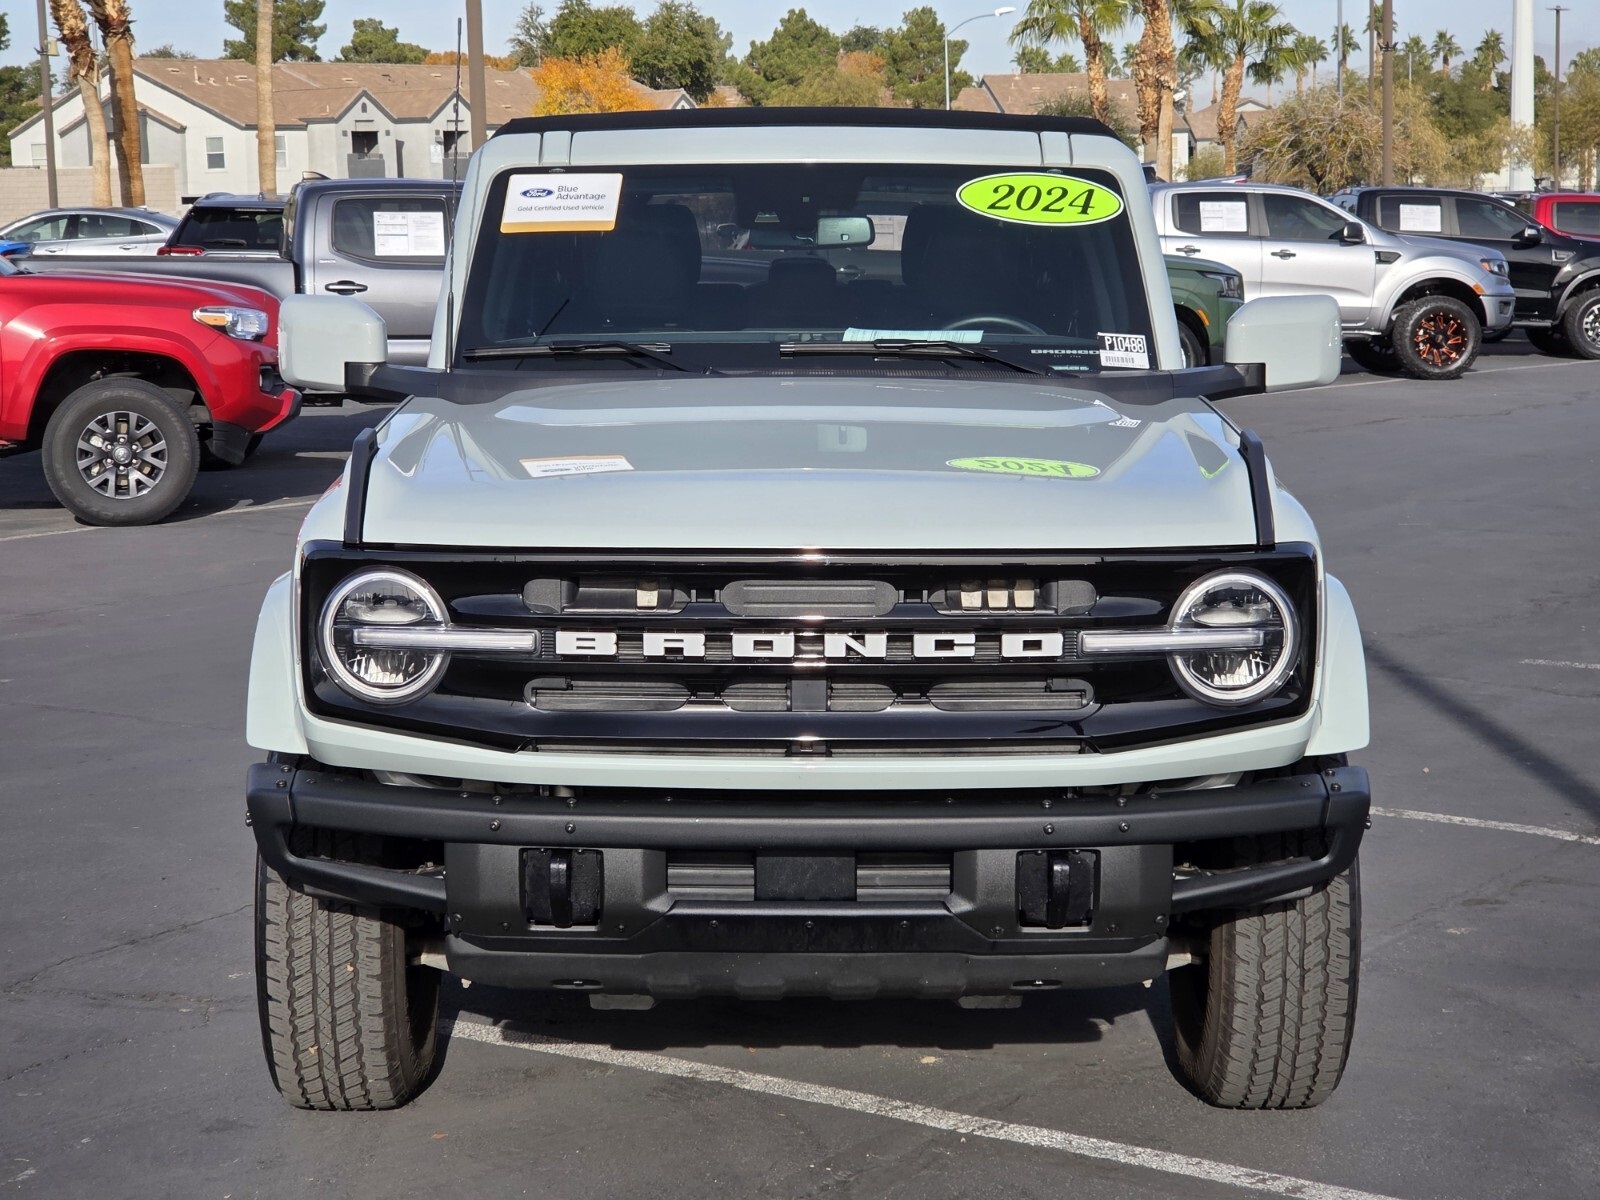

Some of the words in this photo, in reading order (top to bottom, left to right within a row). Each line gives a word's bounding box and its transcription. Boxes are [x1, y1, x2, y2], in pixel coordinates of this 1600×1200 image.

[525, 188, 549, 198] Ford
[557, 185, 579, 193] Blue
[556, 193, 606, 201] Advantage
[986, 184, 1096, 216] 2024
[1104, 336, 1145, 354] P10488
[555, 630, 1064, 659] BRONCO
